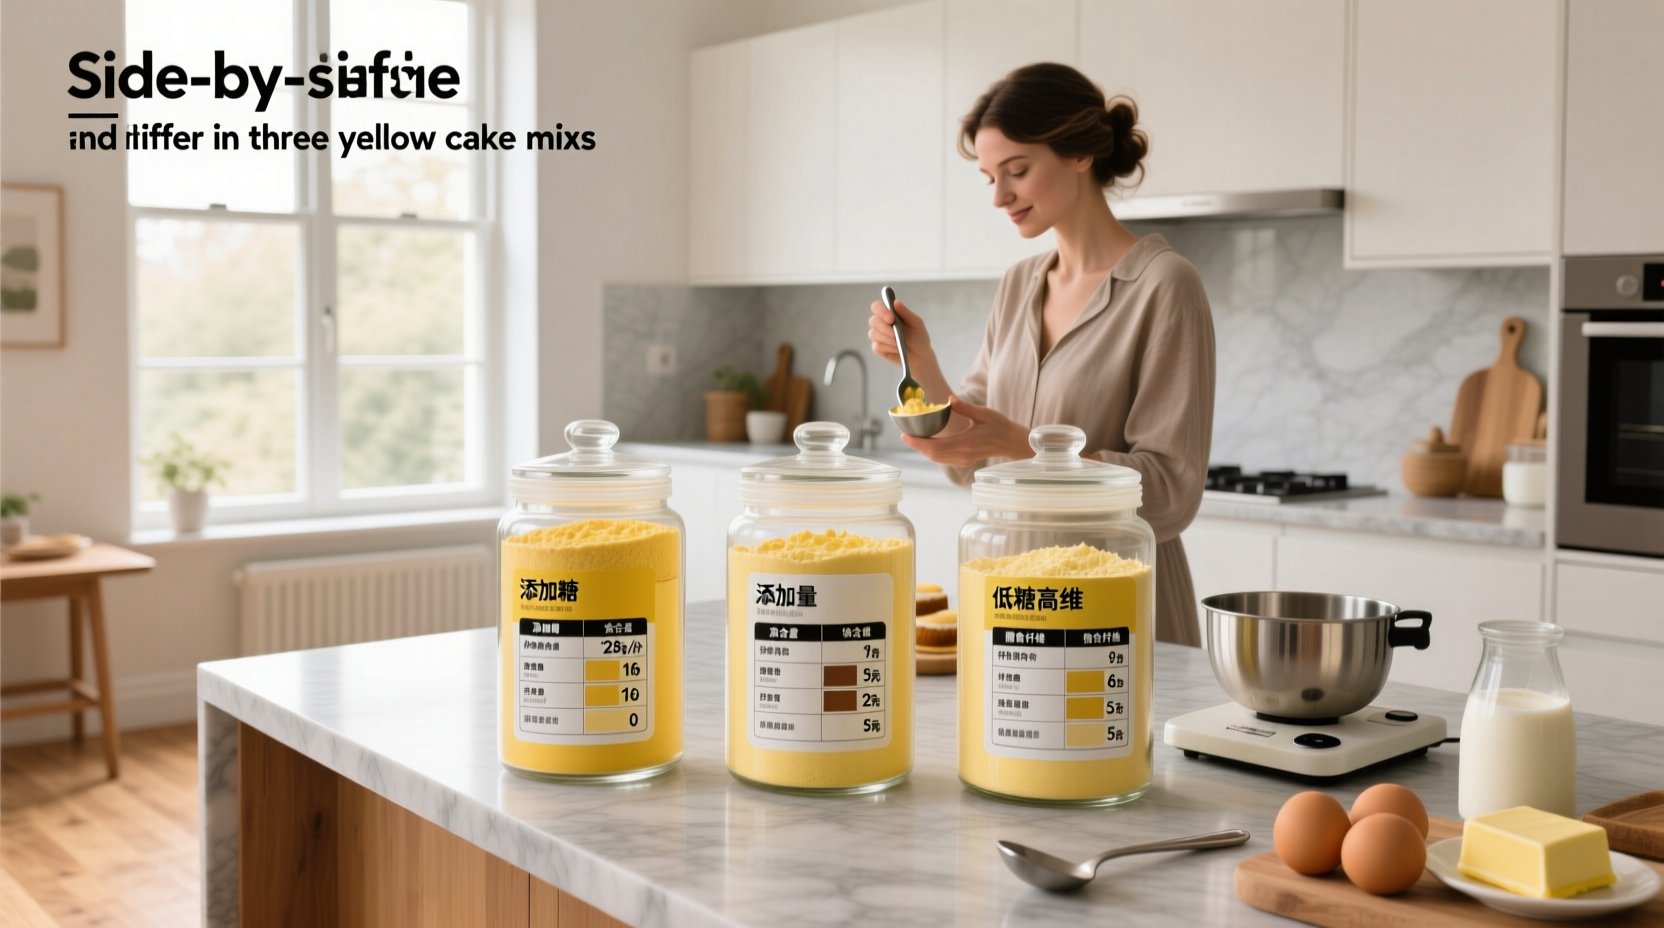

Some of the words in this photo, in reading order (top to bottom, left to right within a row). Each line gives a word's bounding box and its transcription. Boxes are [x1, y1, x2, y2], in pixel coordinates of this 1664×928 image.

[520, 578, 579, 602] 添加糖
[756, 583, 818, 607] 添加量
[992, 586, 1084, 611] 低糖高维
[629, 713, 639, 727] 0
